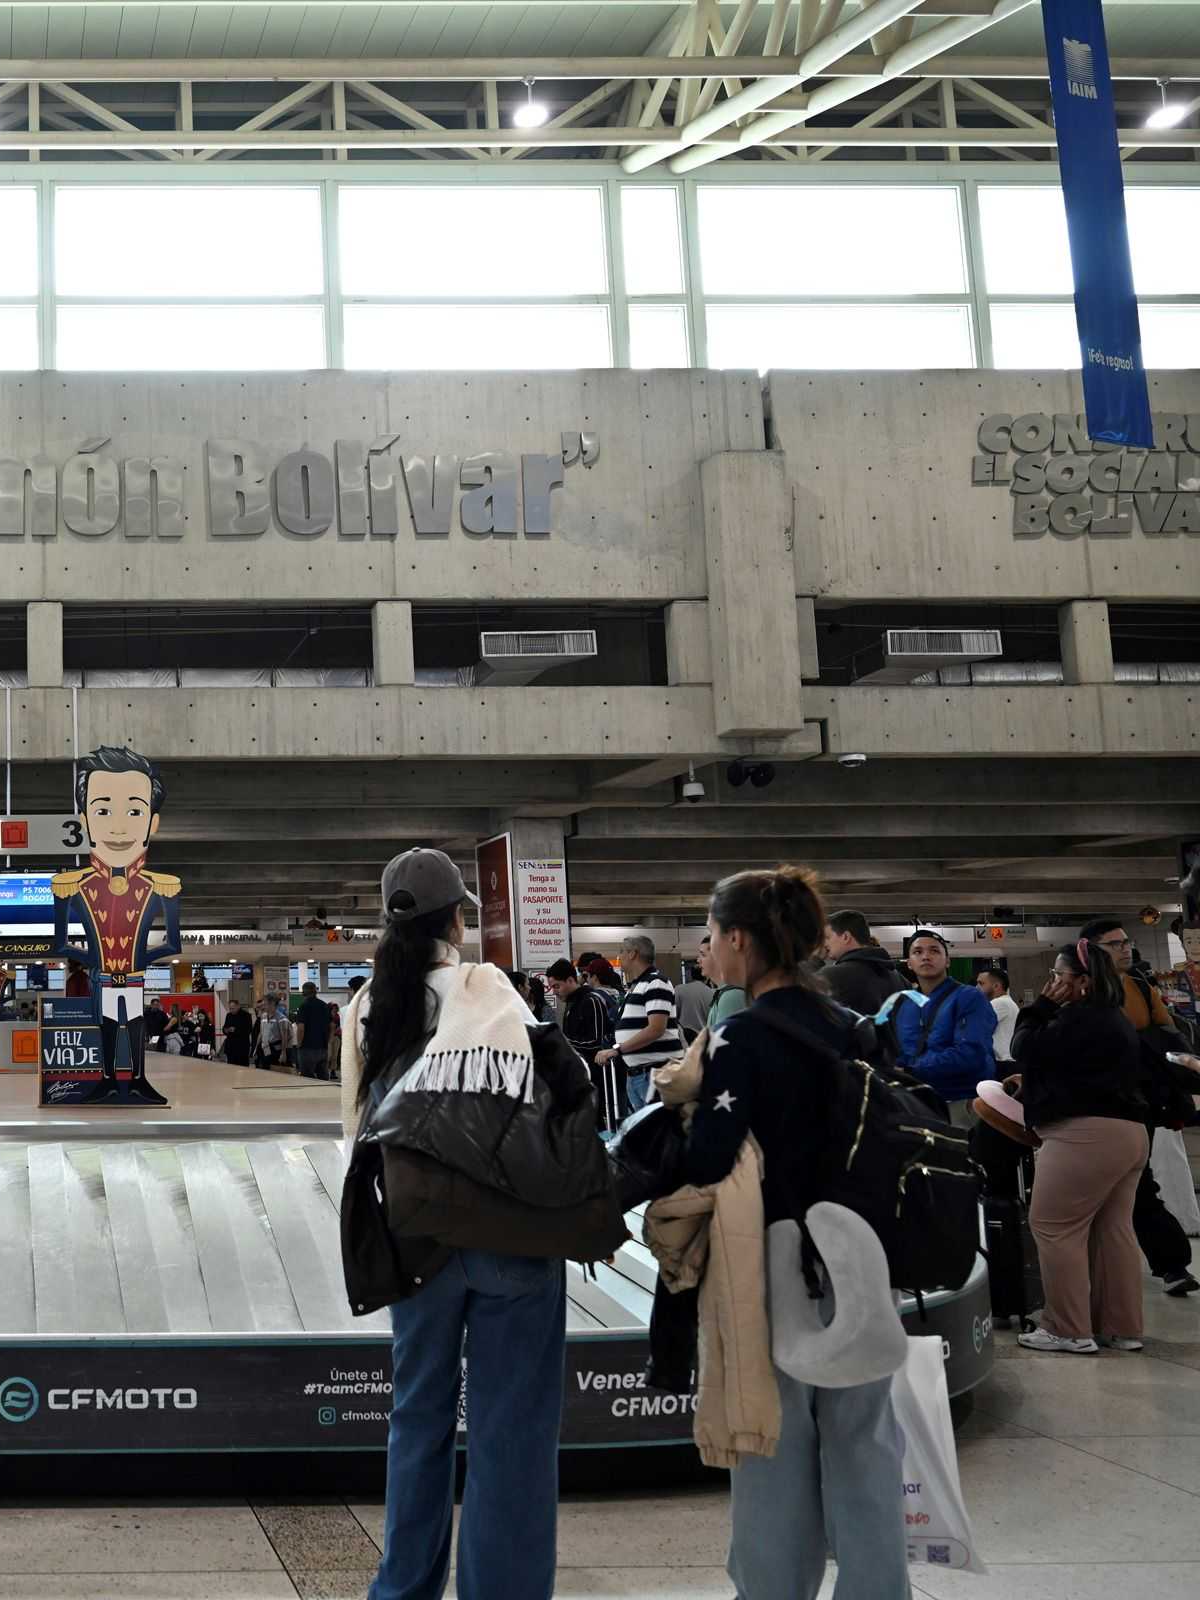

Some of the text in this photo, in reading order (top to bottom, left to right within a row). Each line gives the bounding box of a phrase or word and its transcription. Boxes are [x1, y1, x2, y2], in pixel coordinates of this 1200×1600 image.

[1067, 80, 1098, 99] IAIM
[972, 454, 1010, 486] EL
[207, 430, 602, 537] Bolívar”
[61, 820, 84, 848] 3
[528, 874, 549, 883] Tenga
[522, 895, 564, 904] PASAPORTE
[536, 907, 541, 915] y
[528, 927, 562, 935] de Aduana
[5, 943, 50, 952] CANGURO
[112, 974, 126, 985] SB
[54, 1031, 83, 1047] FELIZ
[43, 1047, 100, 1066] VIAJE
[329, 1367, 383, 1381] Únete al
[576, 1370, 647, 1391] Venez
[303, 1382, 393, 1395] #TeamCFMO
[47, 1388, 197, 1410] CFMOTO
